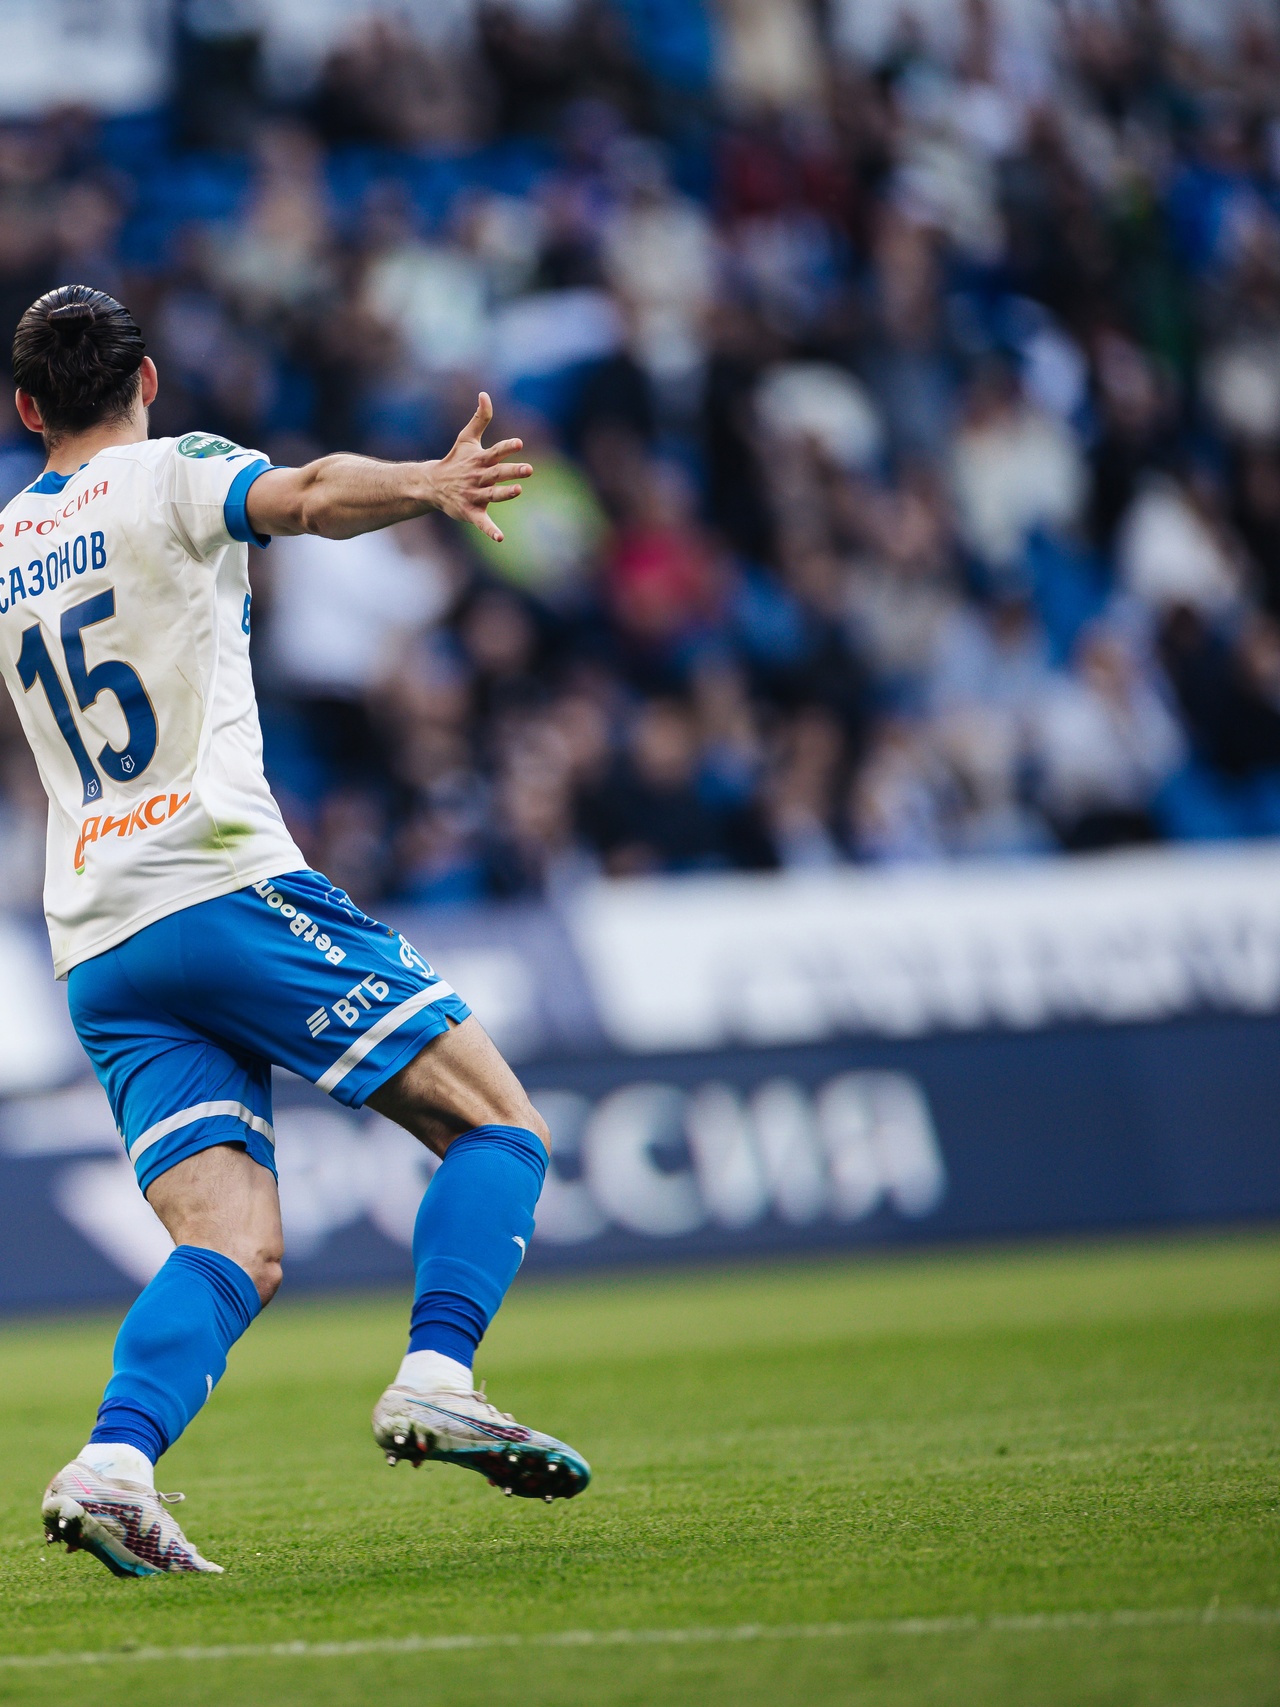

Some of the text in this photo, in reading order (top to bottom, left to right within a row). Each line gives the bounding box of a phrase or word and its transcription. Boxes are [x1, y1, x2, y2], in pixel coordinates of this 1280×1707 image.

[14, 480, 109, 537] РОССИЯ
[15, 585, 160, 808] 15
[331, 972, 390, 1028] ВТБ
